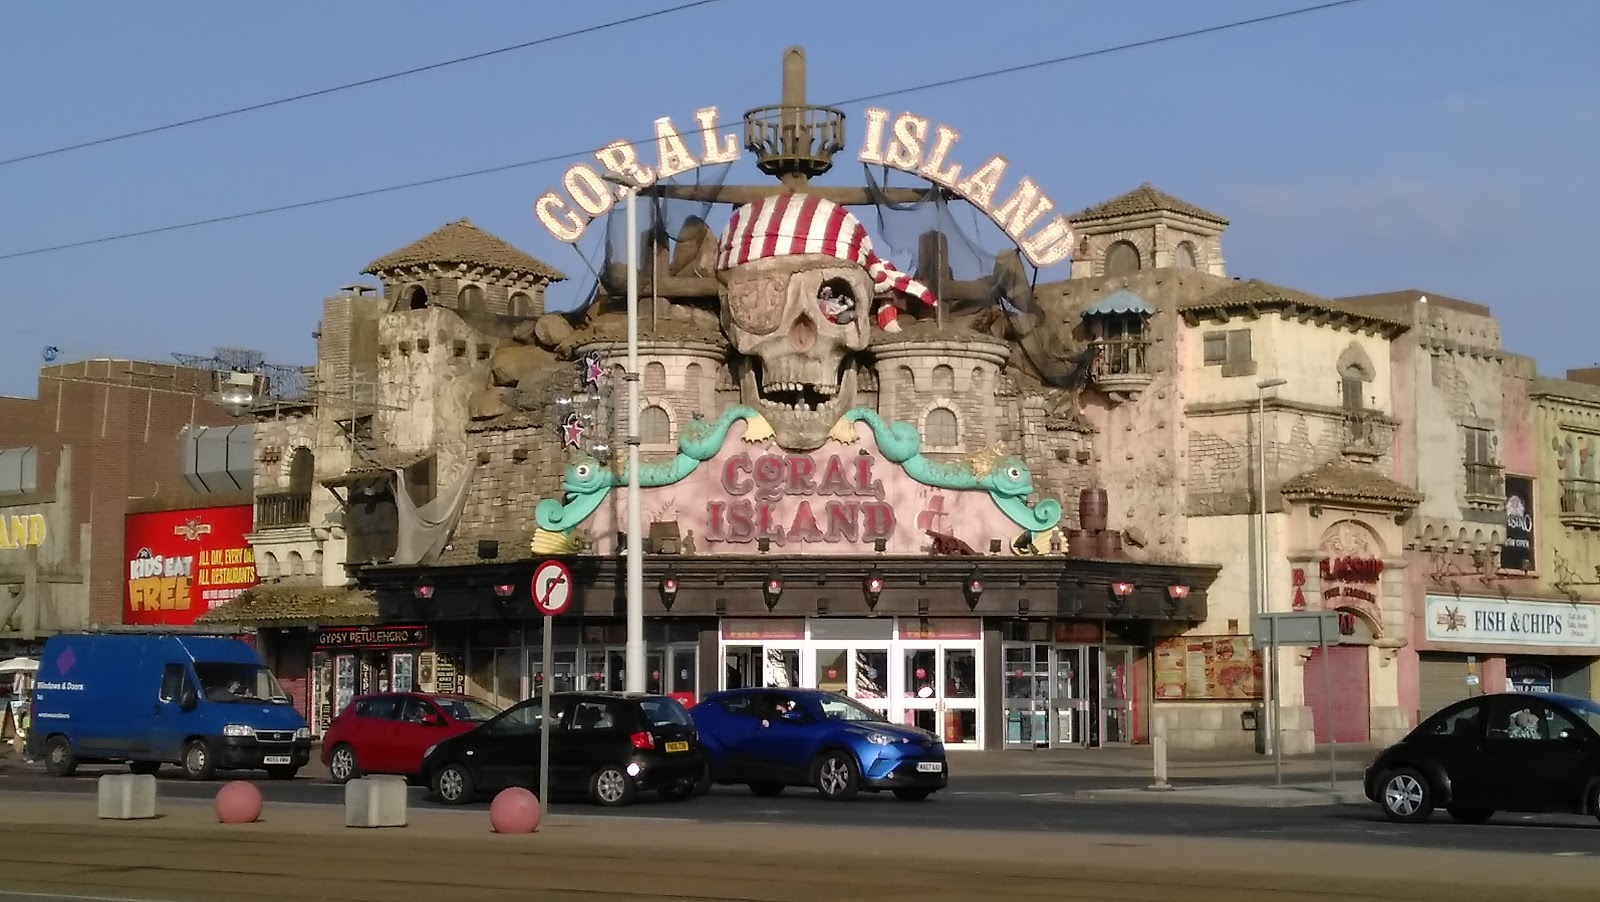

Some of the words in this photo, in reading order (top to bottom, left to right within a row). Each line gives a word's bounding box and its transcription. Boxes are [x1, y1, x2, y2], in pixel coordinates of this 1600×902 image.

[534, 105, 741, 243] CORAL
[858, 107, 1078, 268] ISLAND
[720, 451, 885, 501] CORAL
[706, 499, 897, 547] ISLAND
[130, 555, 163, 580] KIDS
[165, 556, 193, 577] EAT
[199, 550, 210, 566] ALL
[225, 548, 243, 565] EVERY
[198, 568, 210, 585] ALL
[211, 566, 255, 585] RESTAURANTS
[1292, 568, 1307, 613] BA
[129, 576, 193, 611] FREE
[319, 631, 347, 644] GYPSY
[1475, 610, 1506, 632] FISH
[1510, 612, 1521, 632] &
[1522, 612, 1563, 635] CHIPS
[37, 681, 61, 690] Windows
[66, 682, 84, 691] Doors
